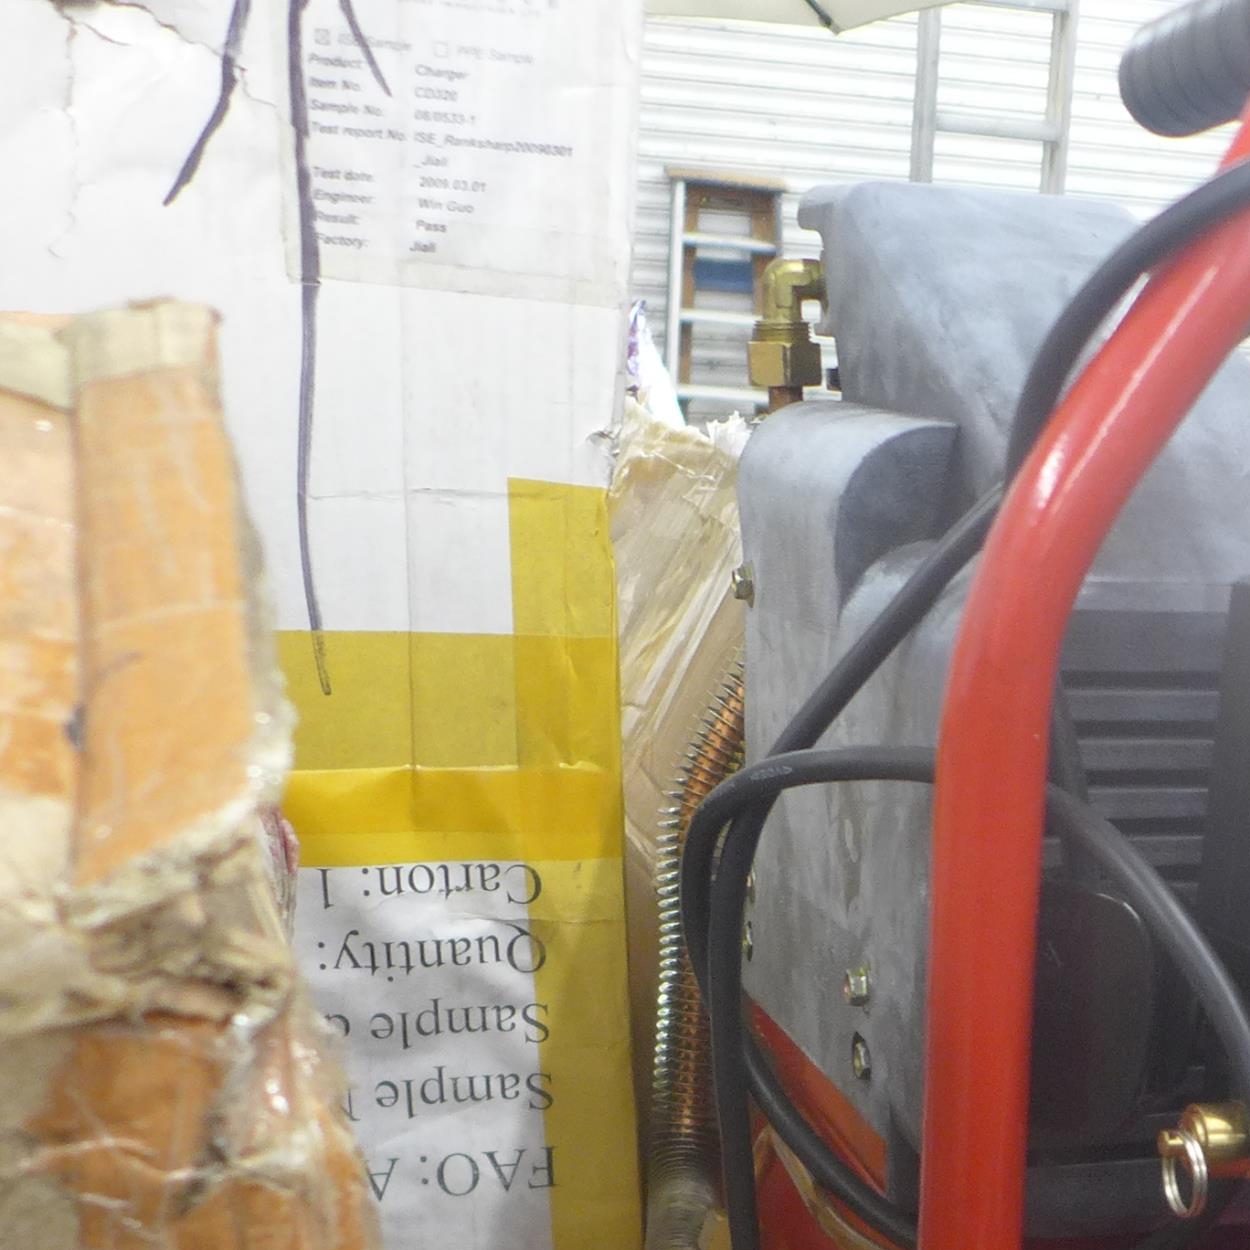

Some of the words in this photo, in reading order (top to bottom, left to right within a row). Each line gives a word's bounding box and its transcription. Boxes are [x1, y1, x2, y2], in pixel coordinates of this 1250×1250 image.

[416, 219, 448, 233] Pass
[362, 863, 543, 905] Carton:
[317, 923, 547, 983] Quantity:
[370, 998, 550, 1050] Sample
[375, 1065, 555, 1120] Sample
[420, 1145, 558, 1197] FAO:
